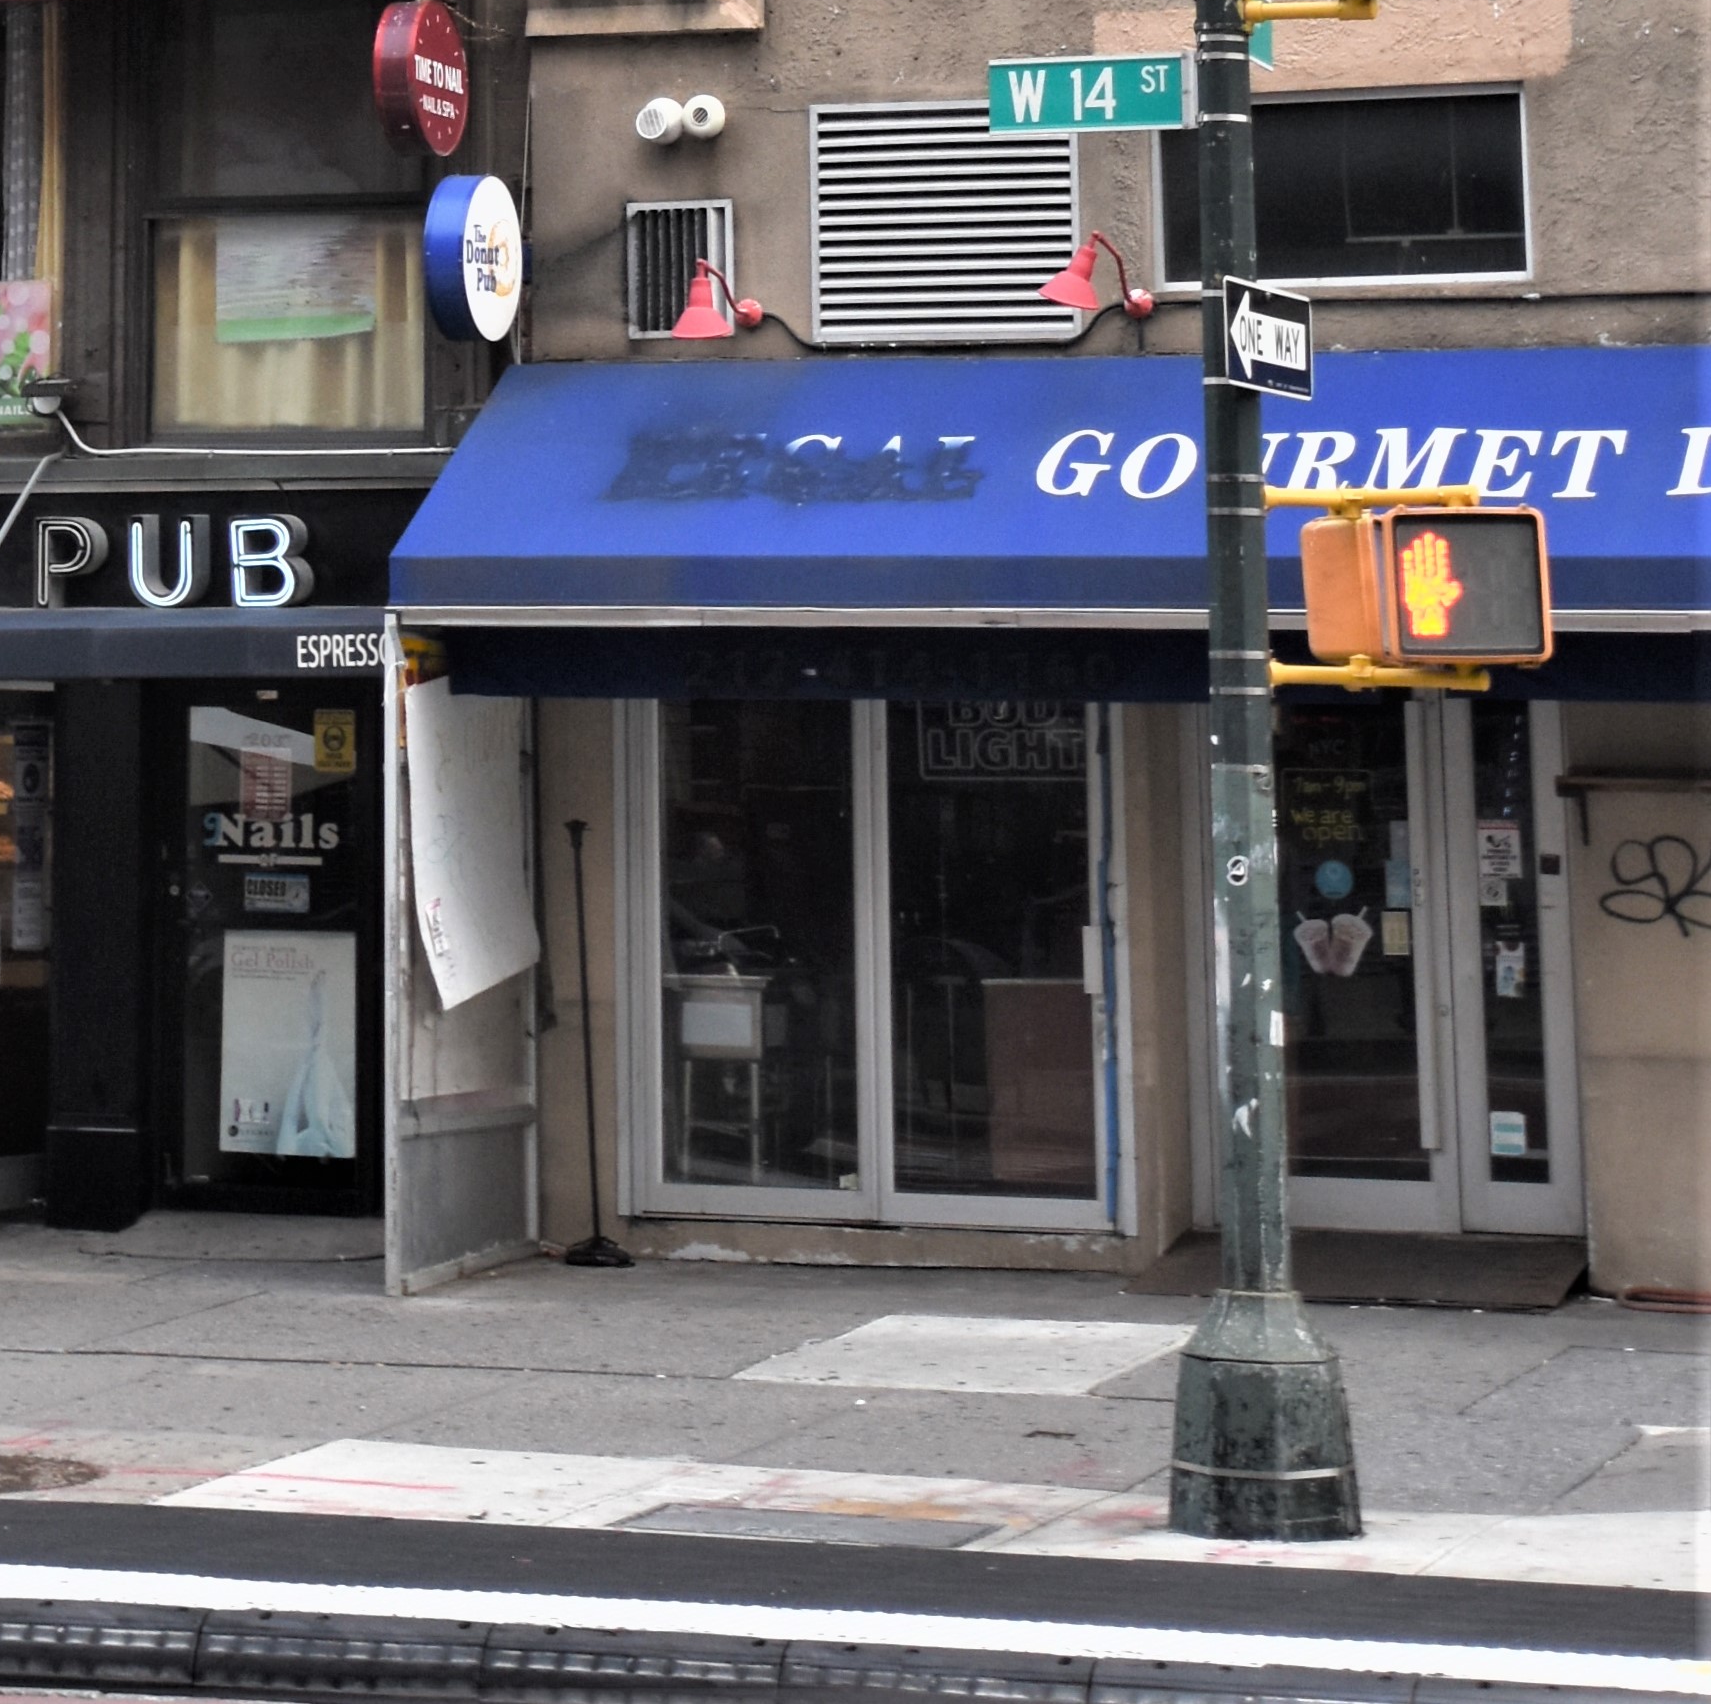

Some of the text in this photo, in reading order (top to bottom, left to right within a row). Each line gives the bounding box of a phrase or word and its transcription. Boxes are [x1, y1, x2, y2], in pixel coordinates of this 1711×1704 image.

[414, 54, 464, 95] TIME TO NAIL
[1007, 64, 1170, 124] W 14 ST
[466, 239, 500, 266] Donut
[473, 224, 487, 243] The
[476, 267, 497, 293] Pub
[1239, 315, 1300, 365] ONE WAY
[1035, 425, 1627, 500] GORMET
[35, 514, 315, 610] PUB
[925, 728, 1087, 771] LIGHT
[201, 812, 340, 850] Nails
[1302, 823, 1365, 849] open
[246, 878, 287, 897] CLOSED
[231, 951, 315, 970] Gel Polish
